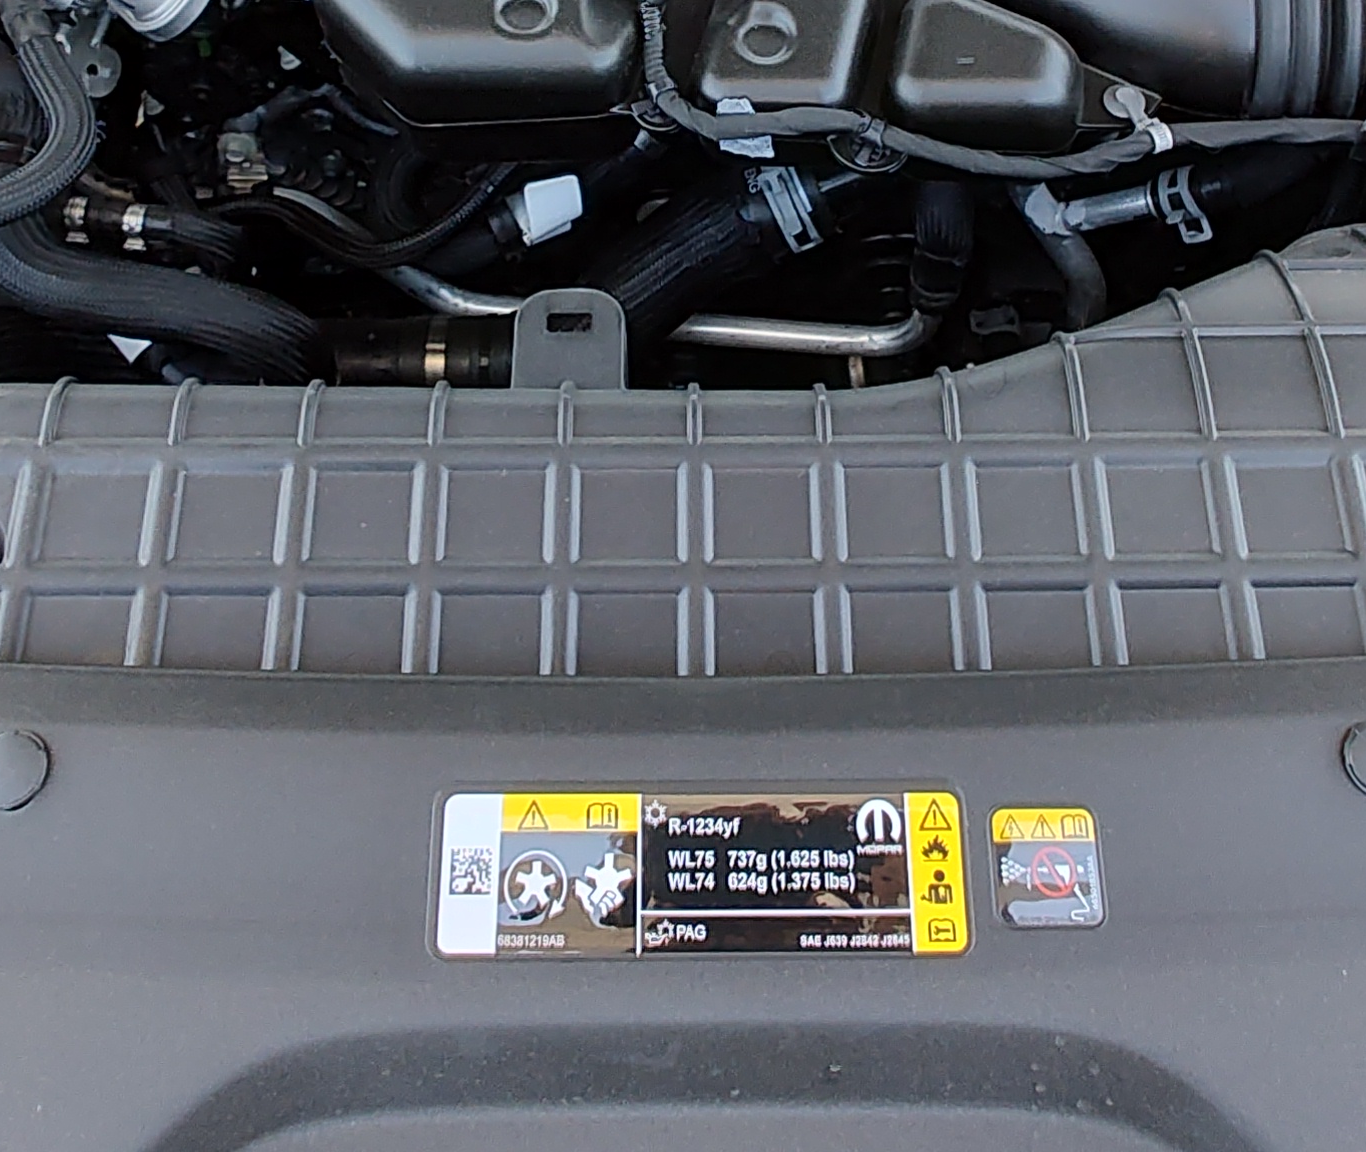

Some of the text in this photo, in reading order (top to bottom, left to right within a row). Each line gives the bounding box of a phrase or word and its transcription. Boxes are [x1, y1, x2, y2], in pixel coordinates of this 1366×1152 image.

[744, 168, 761, 194] ENG
[668, 816, 742, 840] R-1234yf
[667, 849, 855, 873] WL75 737g (1.625 lbs)
[856, 844, 903, 856] MOPAR
[667, 871, 856, 895] WL74 624g (1.375 lbs)
[676, 923, 707, 942] PAG
[799, 934, 822, 948] SAE
[823, 934, 847, 948] J639
